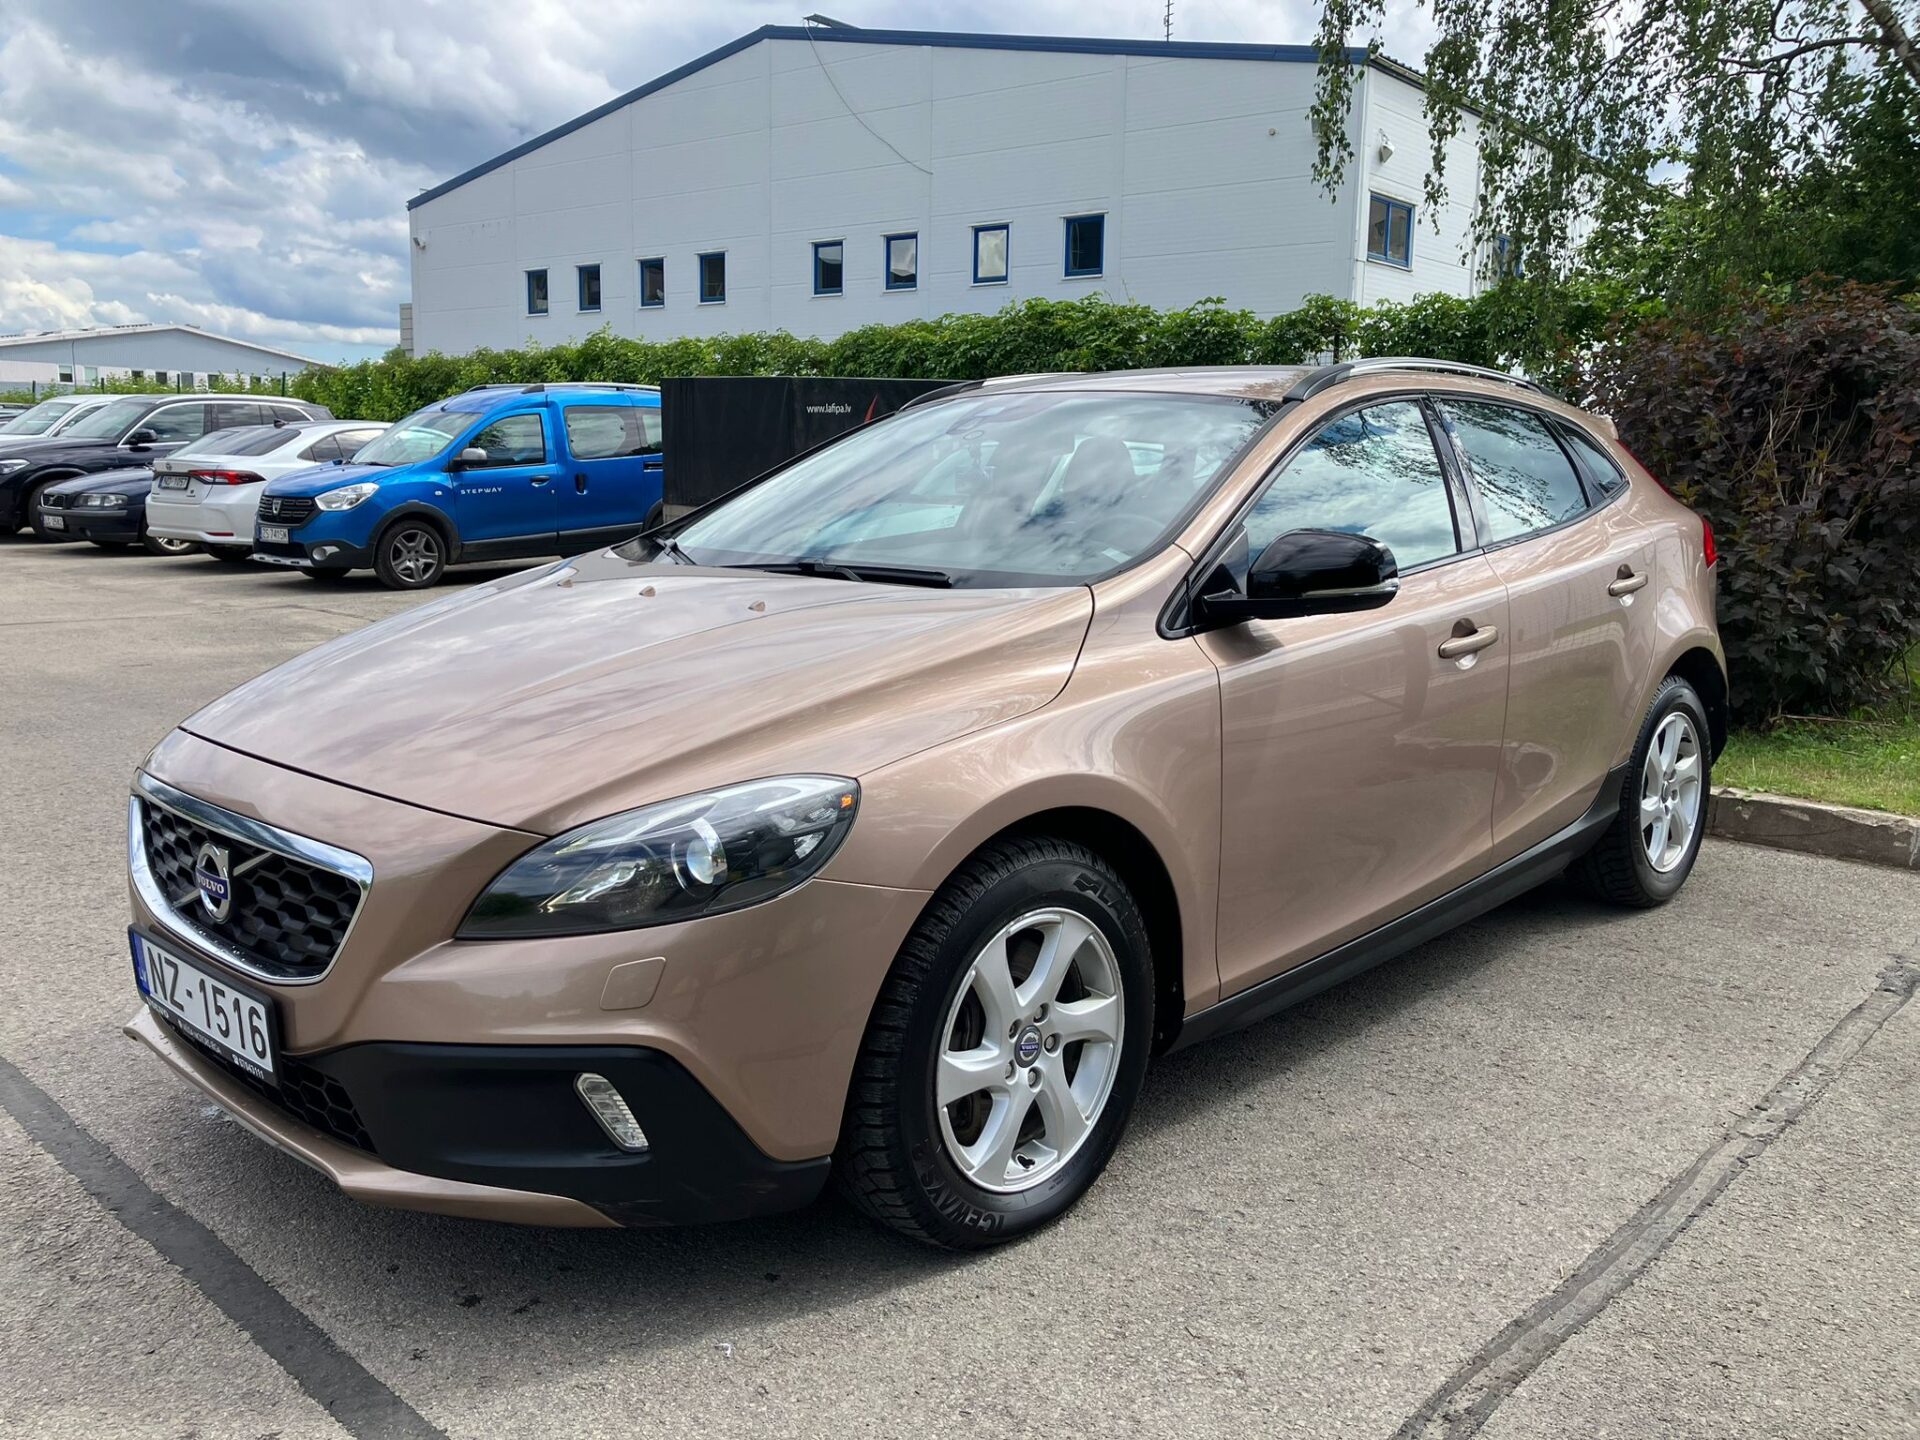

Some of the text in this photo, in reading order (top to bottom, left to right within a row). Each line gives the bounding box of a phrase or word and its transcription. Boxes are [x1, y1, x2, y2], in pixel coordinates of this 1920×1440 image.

[806, 402, 852, 416] www.lafipa.lv
[460, 486, 503, 495] STEPWAY
[195, 872, 225, 895] VOLVO
[146, 945, 267, 1060] NZ-1516
